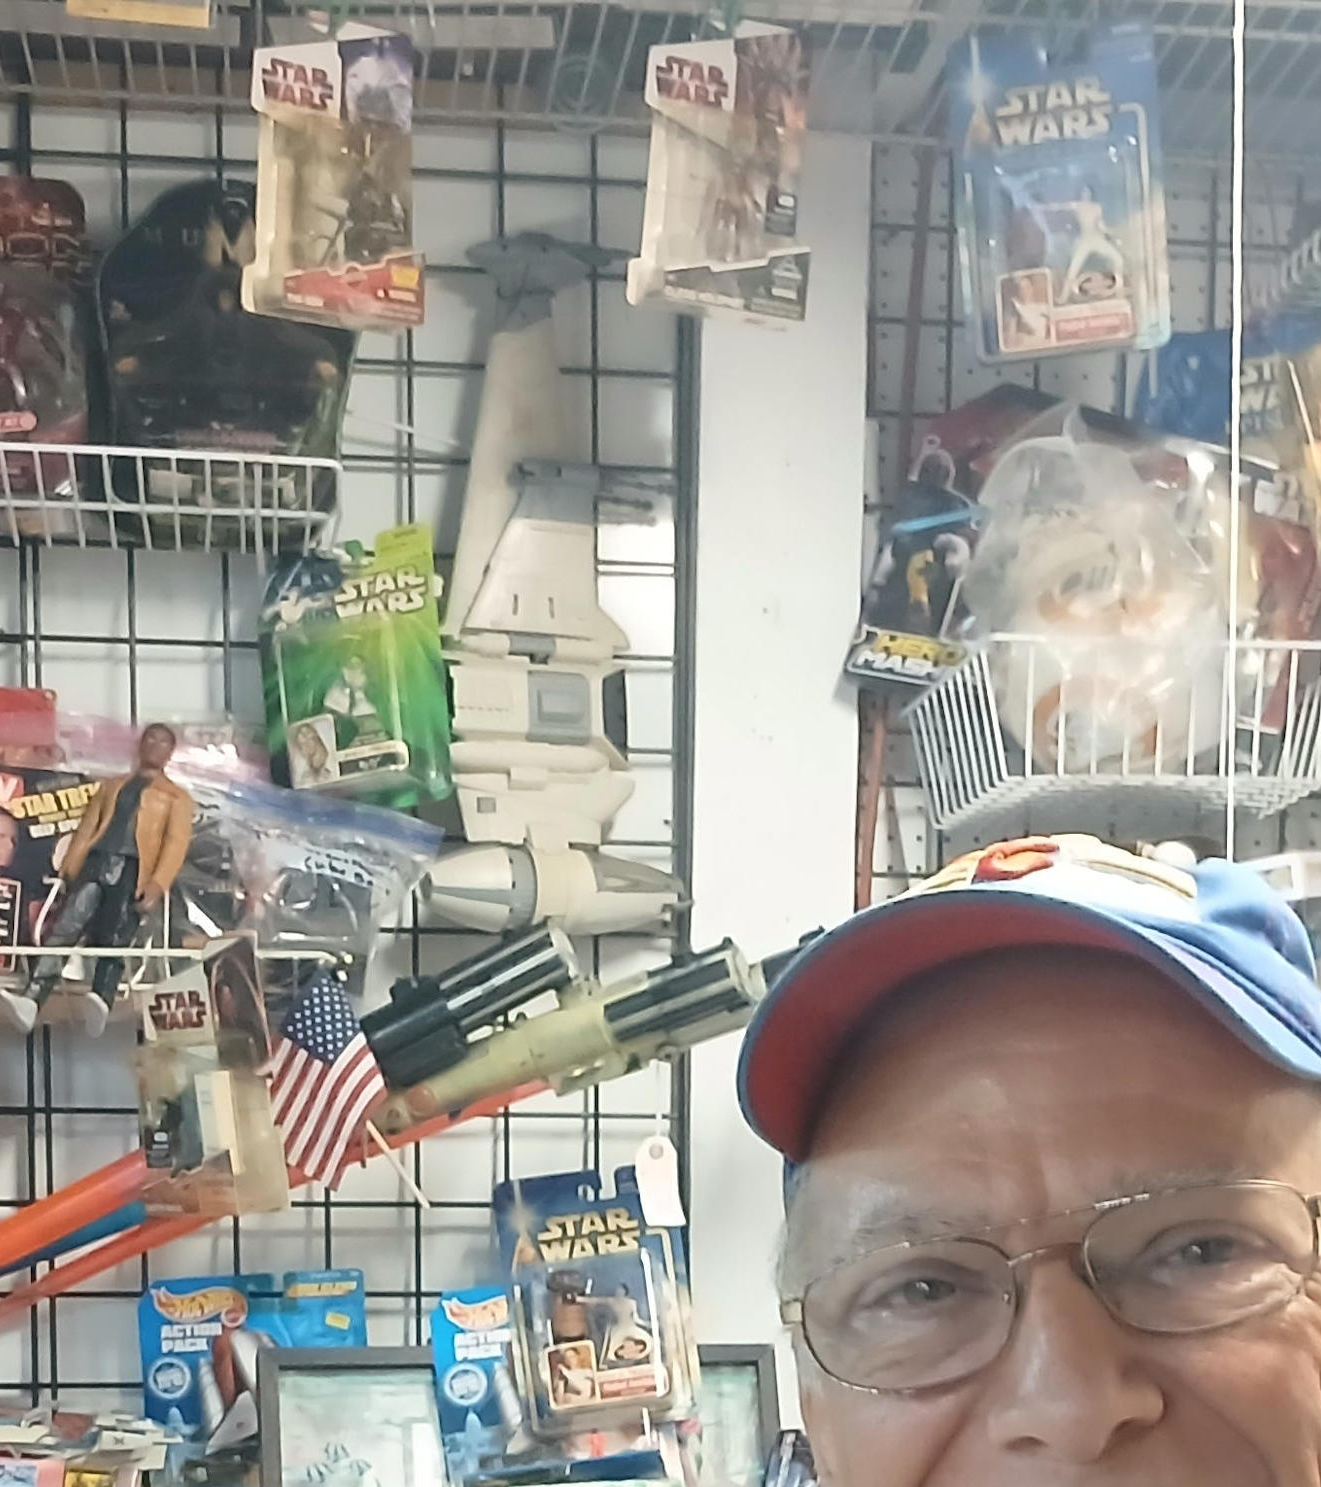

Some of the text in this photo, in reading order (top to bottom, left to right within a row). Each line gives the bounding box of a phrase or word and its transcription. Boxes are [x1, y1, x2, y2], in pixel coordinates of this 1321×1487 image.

[262, 57, 334, 92] STAR
[656, 54, 728, 91] STAR
[262, 79, 334, 111] WARS
[995, 75, 1112, 117] STAR
[996, 103, 1114, 146] WARS
[334, 564, 425, 600] STAR
[334, 583, 428, 620] WARS
[148, 990, 207, 1013] STAR
[150, 1006, 207, 1030] WARS
[537, 1207, 640, 1242] STAR
[537, 1229, 642, 1264] WARS
[161, 1322, 223, 1339] ACTION
[161, 1337, 209, 1354] PACK
